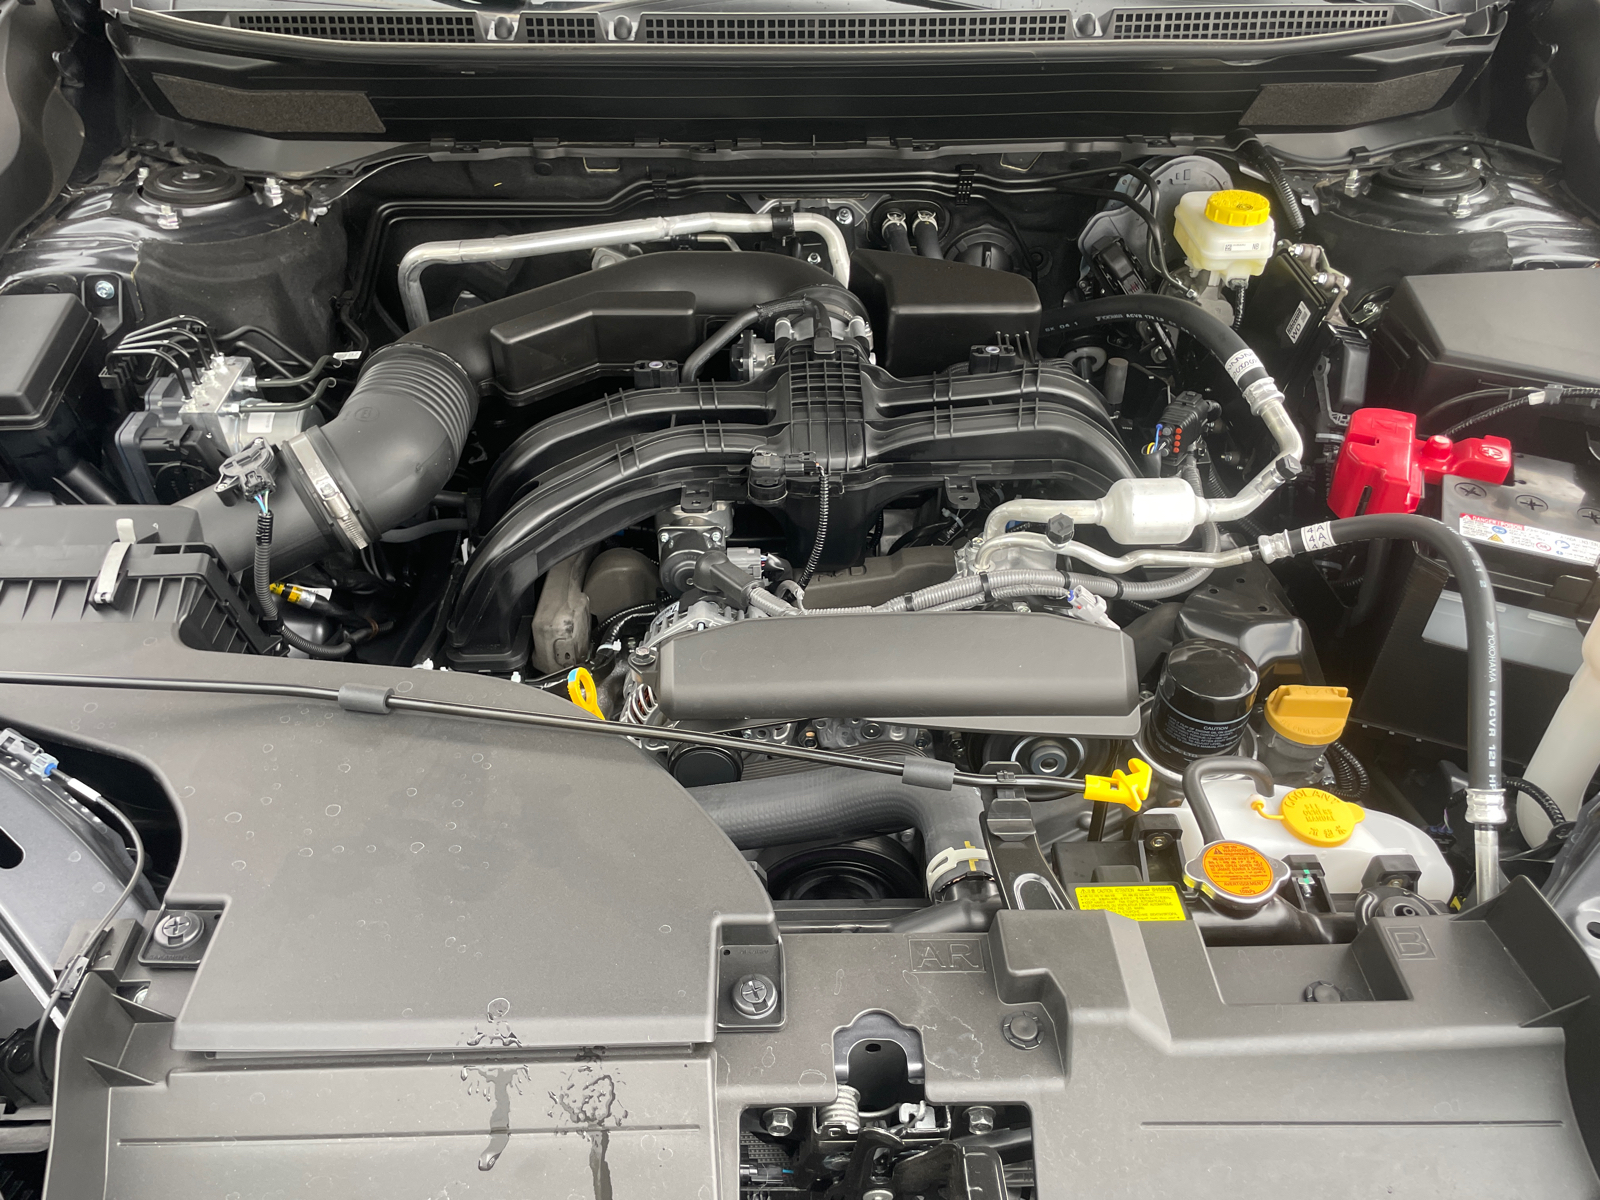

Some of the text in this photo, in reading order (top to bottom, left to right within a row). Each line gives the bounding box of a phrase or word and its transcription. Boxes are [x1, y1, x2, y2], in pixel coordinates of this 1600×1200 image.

[1488, 634, 1496, 682] YOKOHAMA
[1284, 790, 1340, 808] COOLANT
[915, 942, 979, 968] AR
[1392, 931, 1428, 956] B
